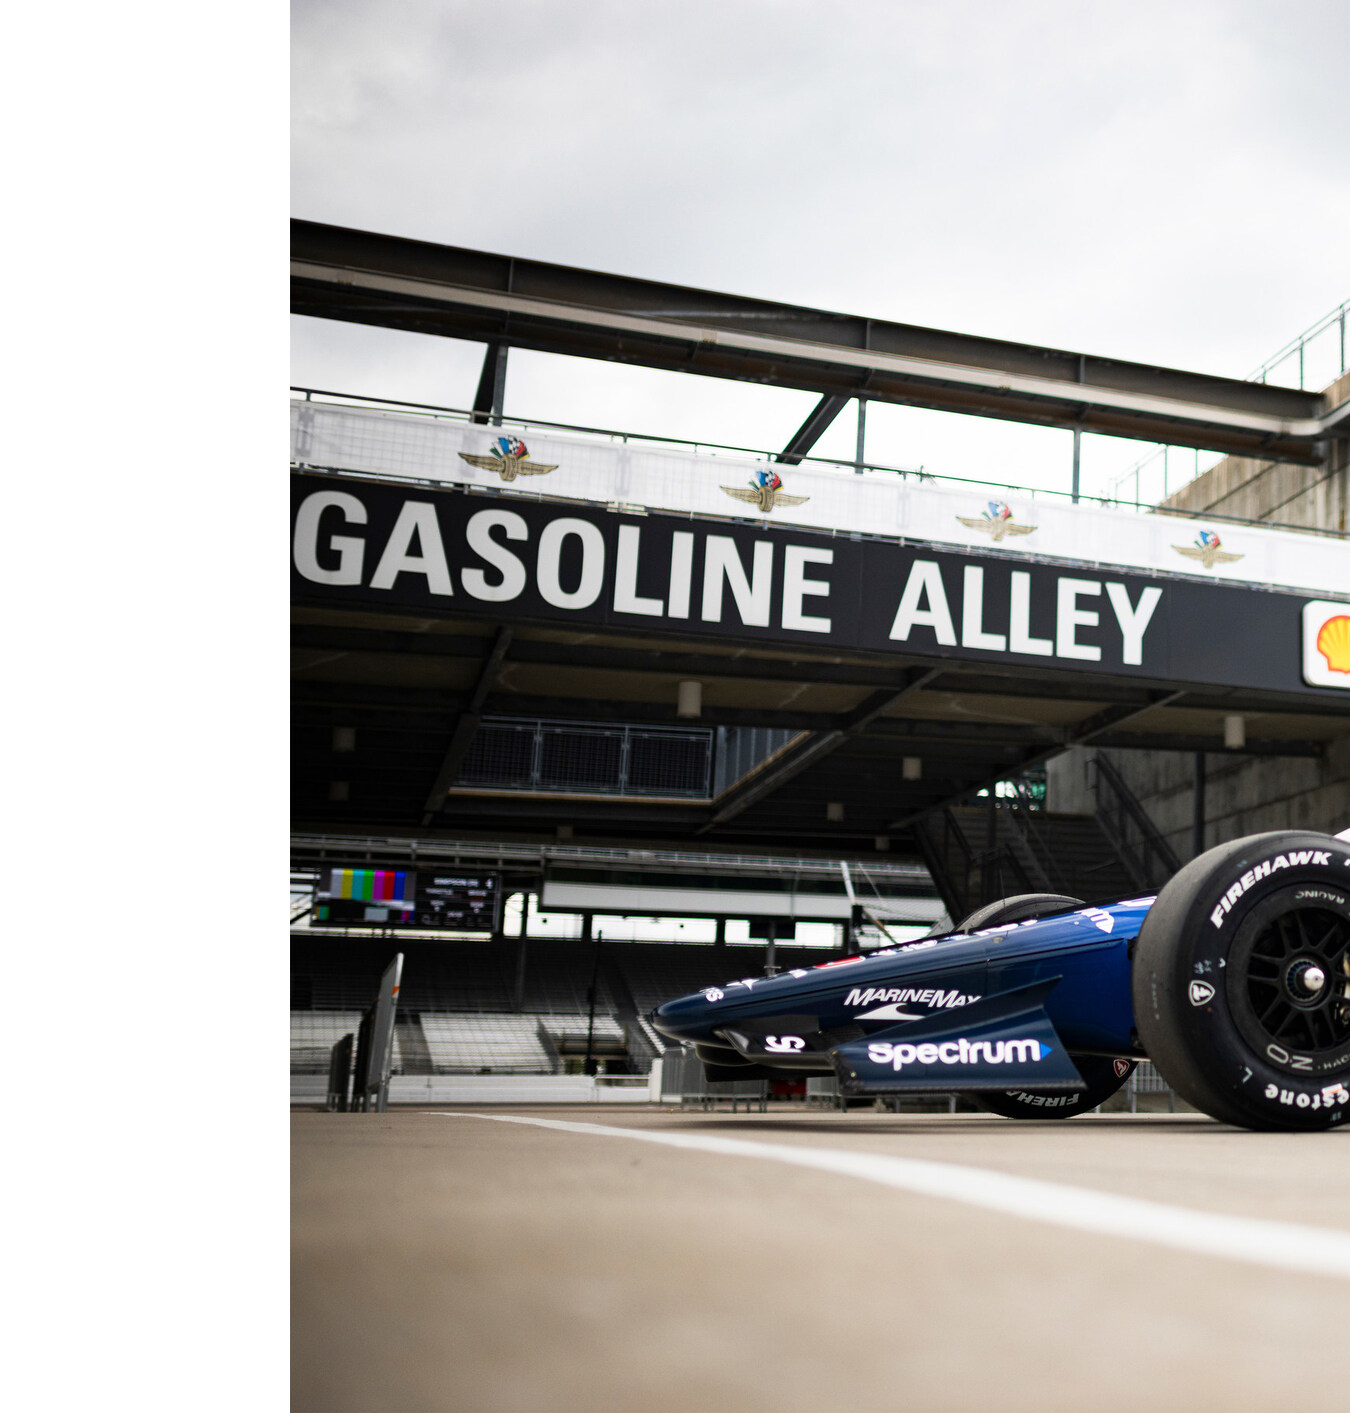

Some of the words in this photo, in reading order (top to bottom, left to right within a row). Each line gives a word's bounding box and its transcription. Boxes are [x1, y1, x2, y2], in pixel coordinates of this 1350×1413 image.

[293, 491, 833, 633] GASOLINE
[889, 560, 1163, 665] ALLEY
[1210, 851, 1332, 928] FIREHAWK
[868, 1038, 1042, 1072] Spectrum
